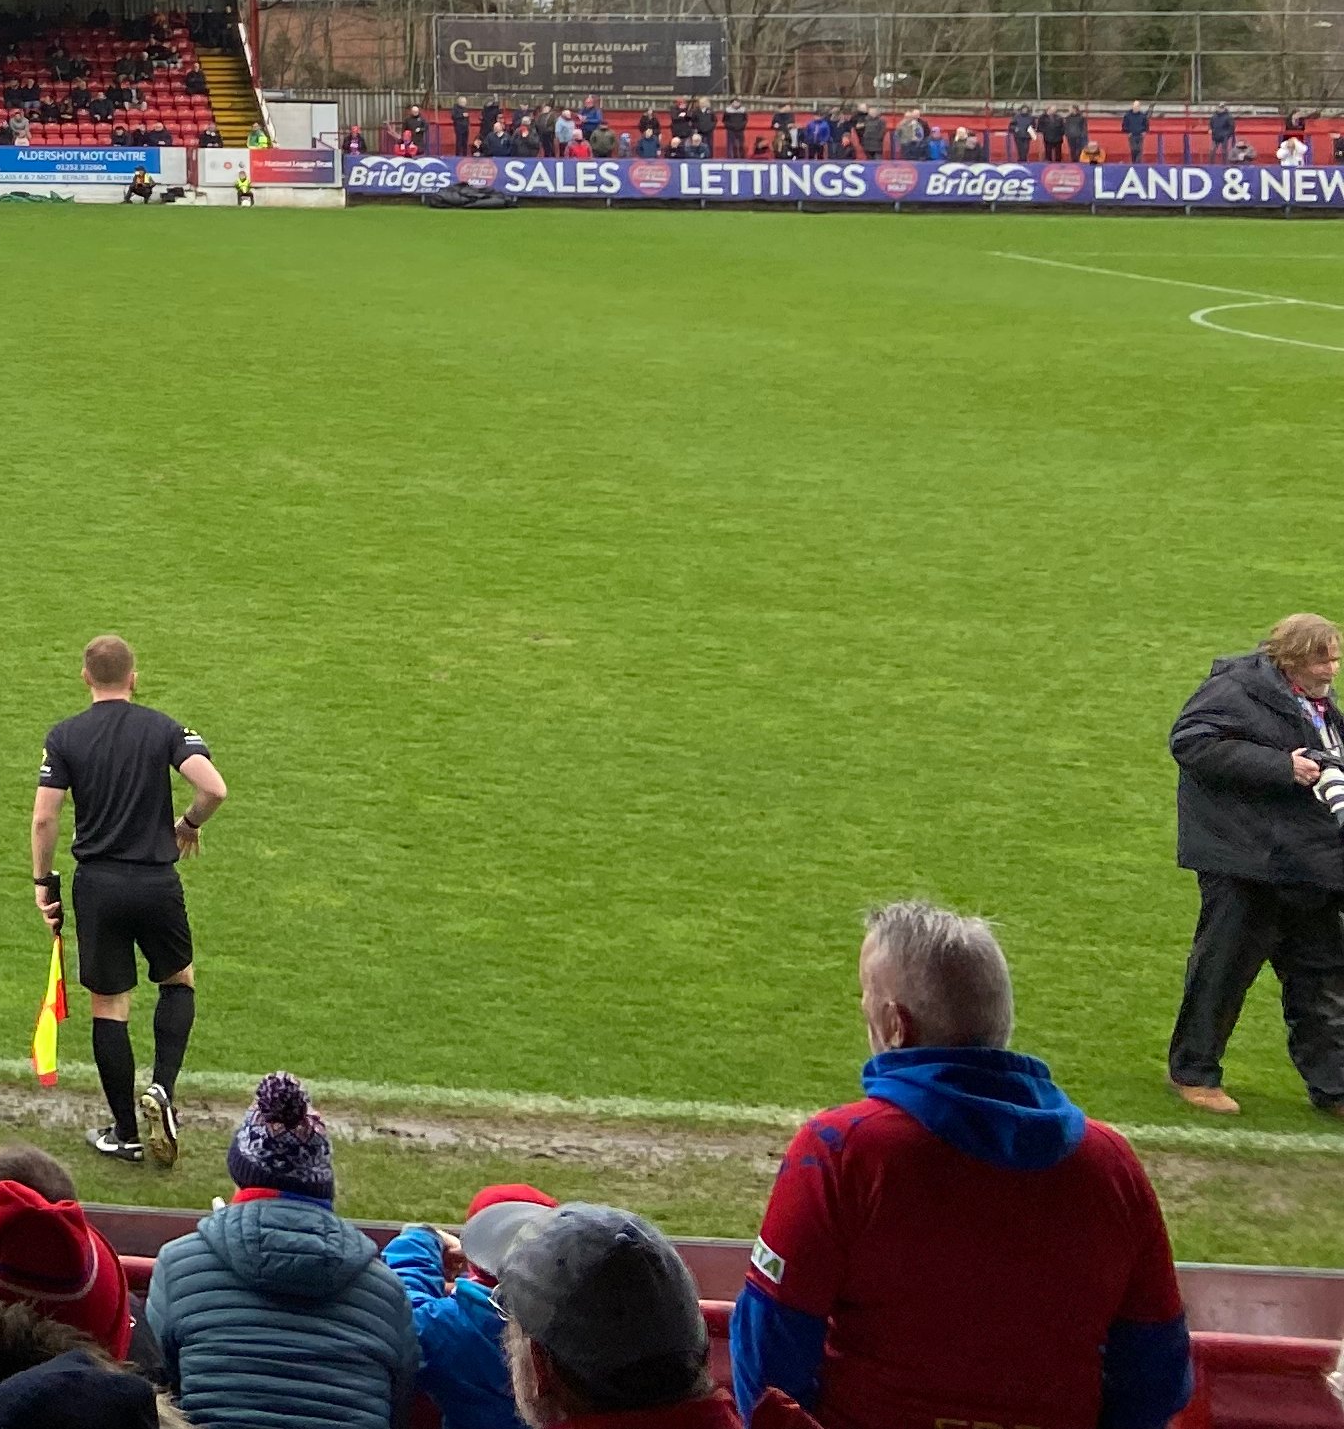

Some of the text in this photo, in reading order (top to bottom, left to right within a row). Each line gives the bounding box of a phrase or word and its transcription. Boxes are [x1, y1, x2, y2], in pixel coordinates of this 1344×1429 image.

[562, 42, 649, 53] RESTAURANT
[562, 65, 614, 75] EVENTS
[17, 150, 147, 162] ALDERSHOT MOT CENTRE
[348, 164, 452, 193] Bridges
[504, 160, 622, 193] SALES
[680, 162, 867, 198] LETTINGS
[925, 171, 1035, 202] Bridges
[1093, 165, 1213, 201] LAND
[1221, 166, 1252, 202] &
[1260, 167, 1344, 203] NEW
